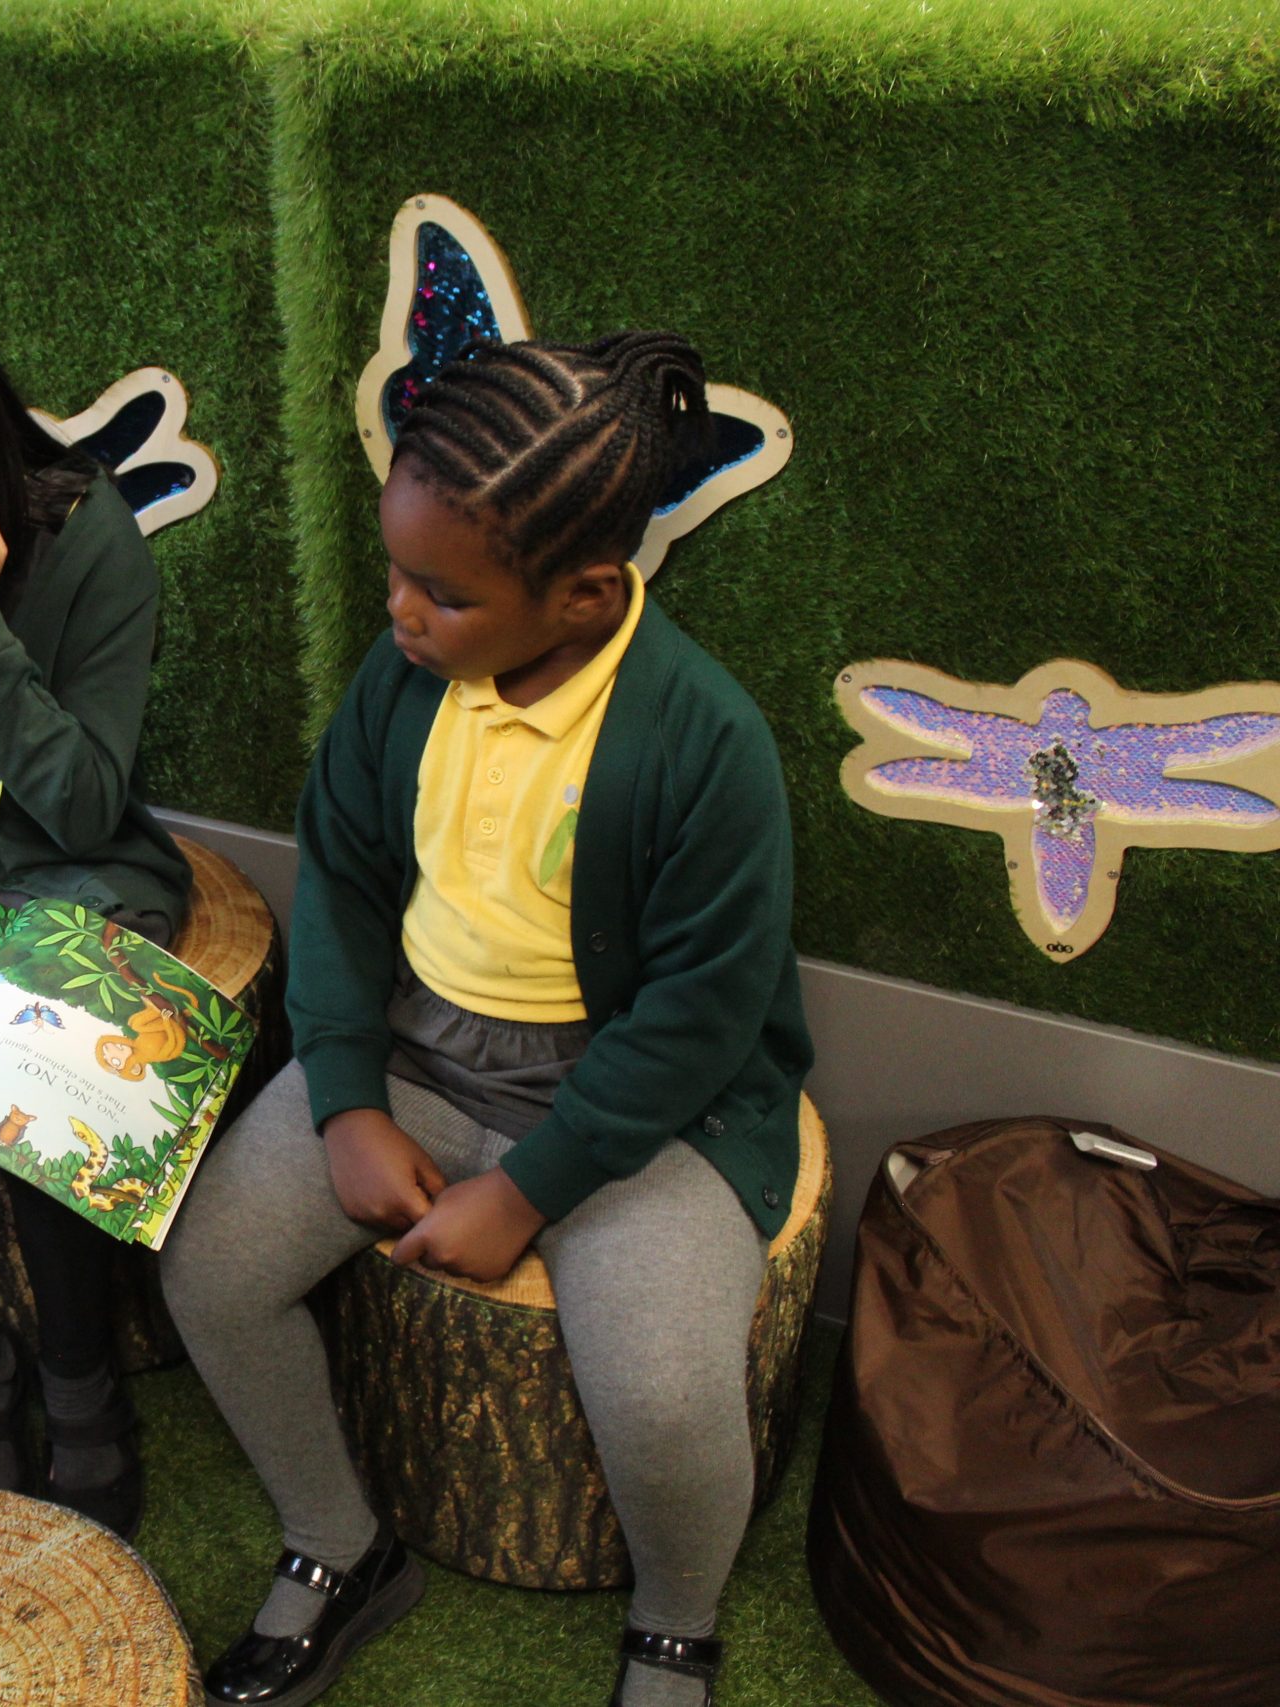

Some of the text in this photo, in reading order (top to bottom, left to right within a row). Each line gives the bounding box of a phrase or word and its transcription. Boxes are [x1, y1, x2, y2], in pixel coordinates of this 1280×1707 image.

[17, 1058, 58, 1087] NO!
[34, 1050, 78, 1080] elephant
[63, 1080, 91, 1105] NO,
[78, 1075, 96, 1092] the
